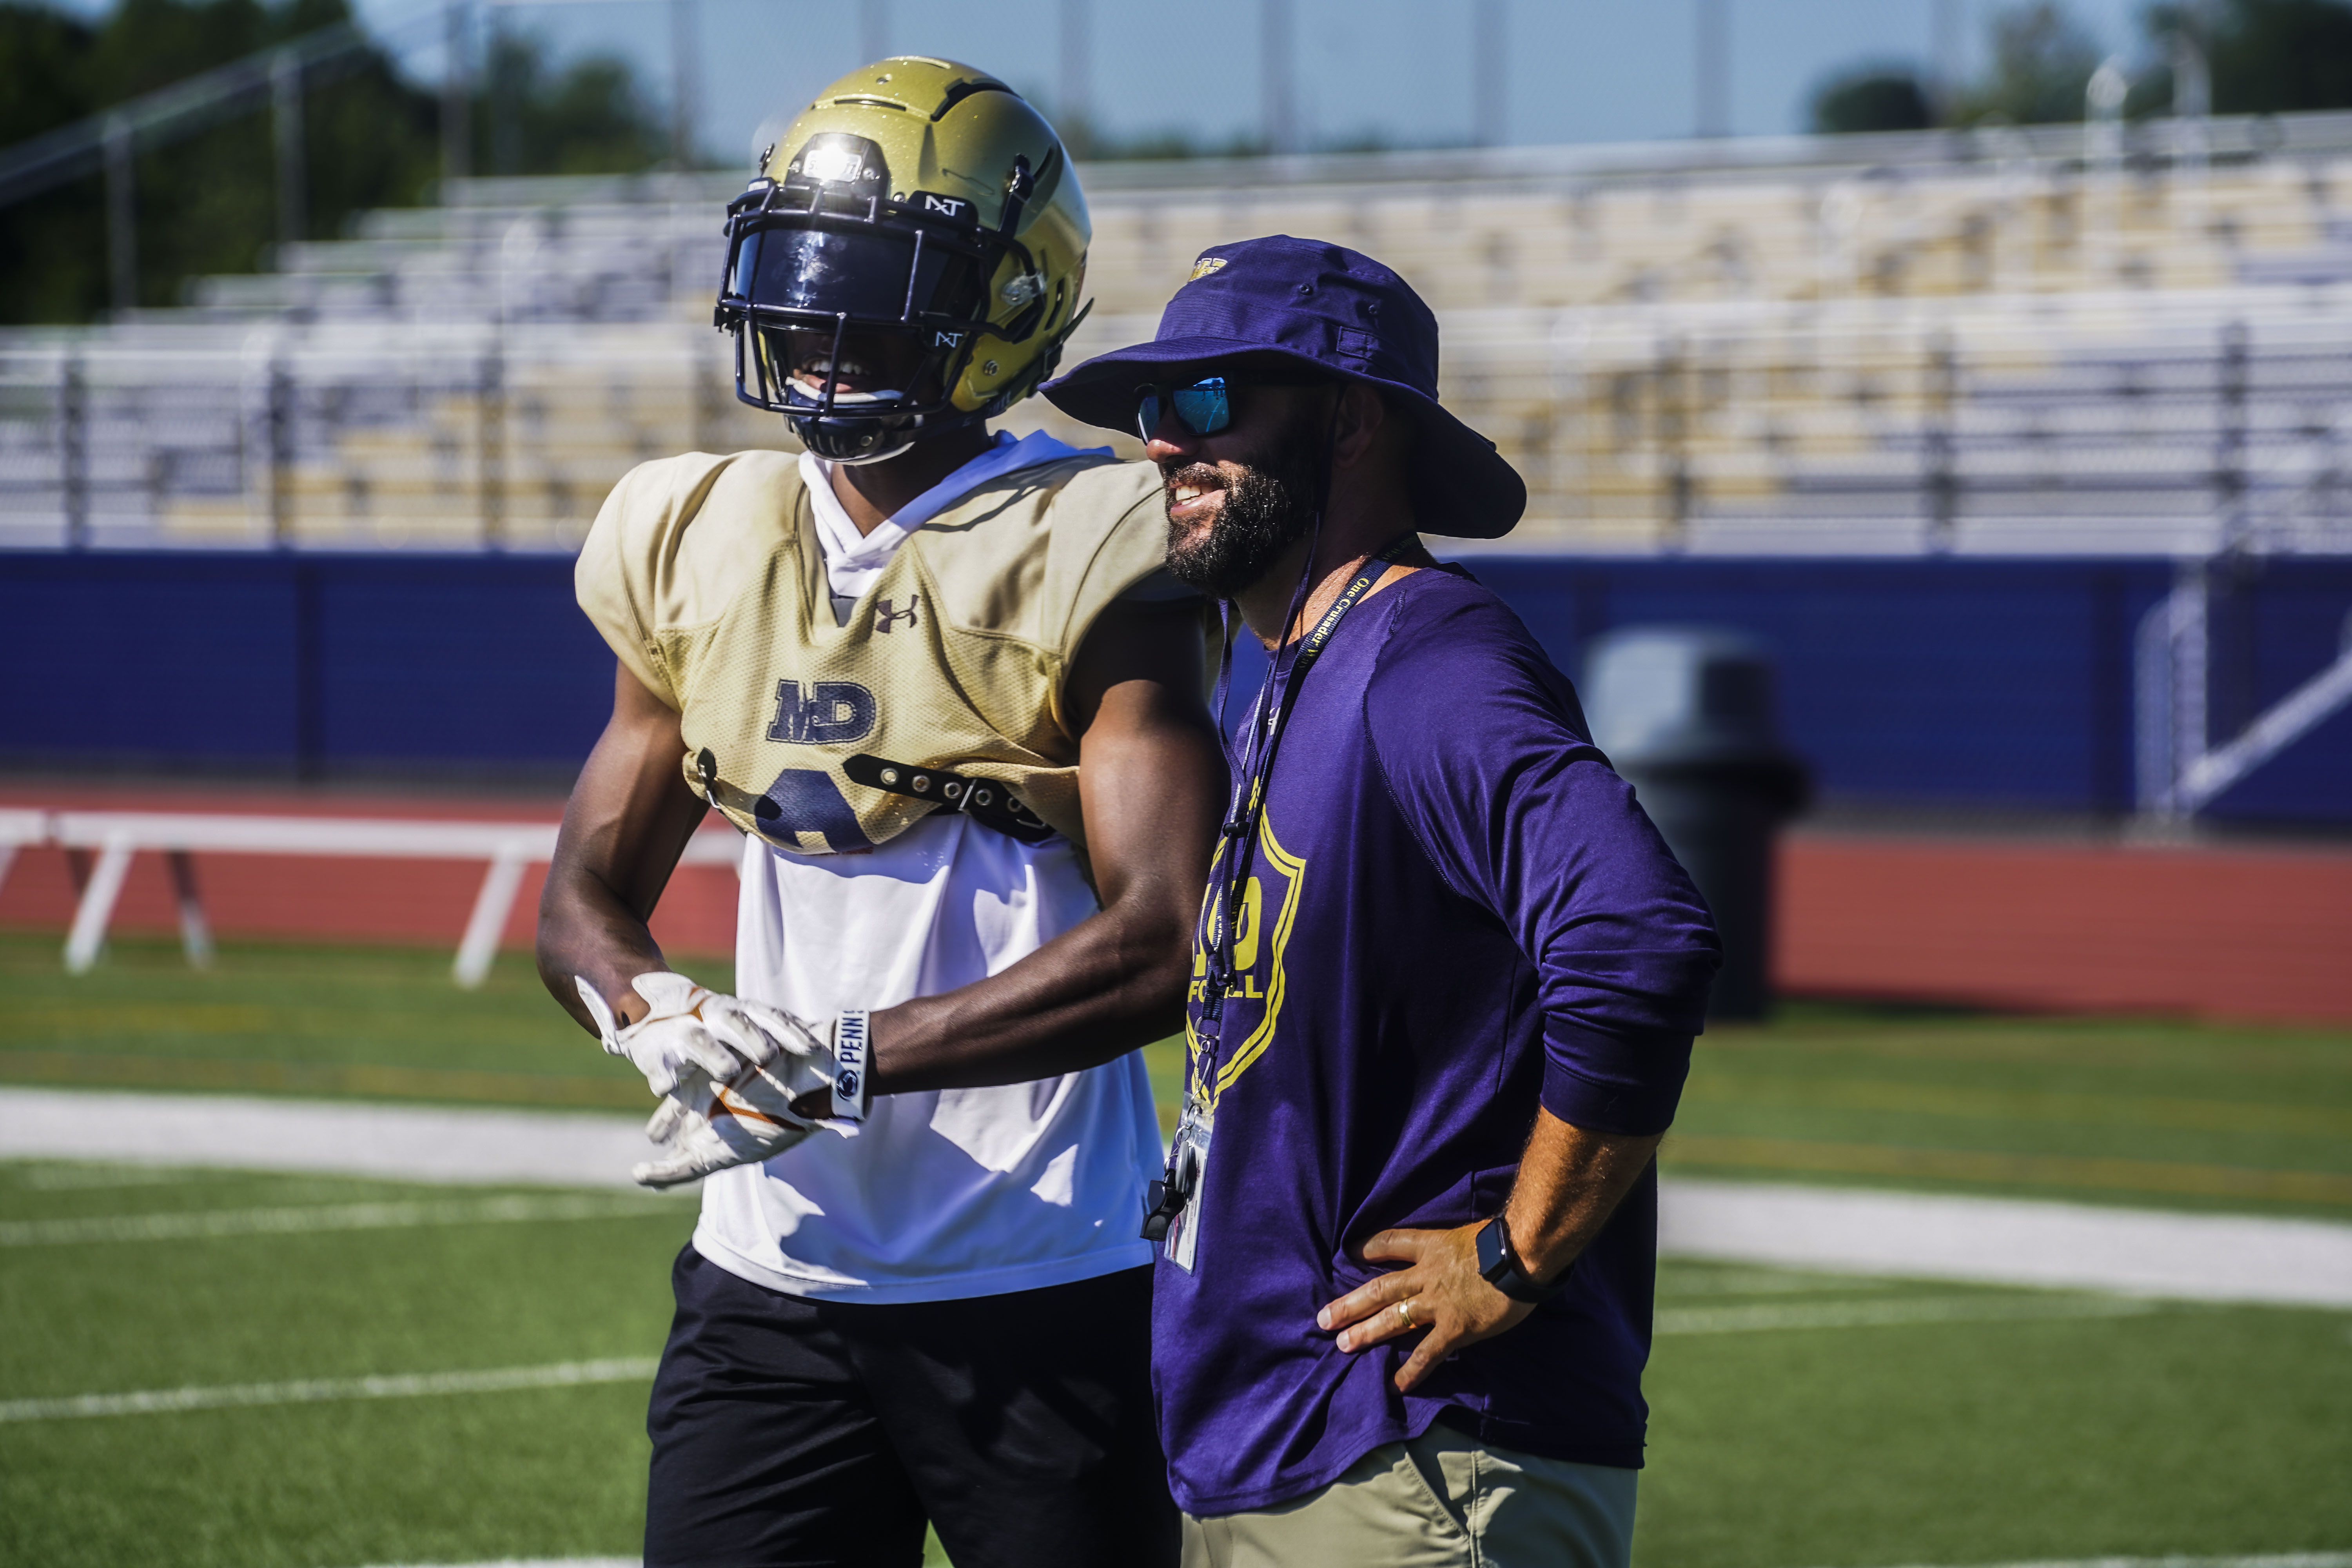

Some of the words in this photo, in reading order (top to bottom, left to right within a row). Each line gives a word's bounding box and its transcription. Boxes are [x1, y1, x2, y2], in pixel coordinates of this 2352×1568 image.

[1347, 578, 1369, 597] One
[1311, 599, 1350, 646] Crusader
[766, 679, 876, 745] MD
[840, 1018, 864, 1064] PENN
